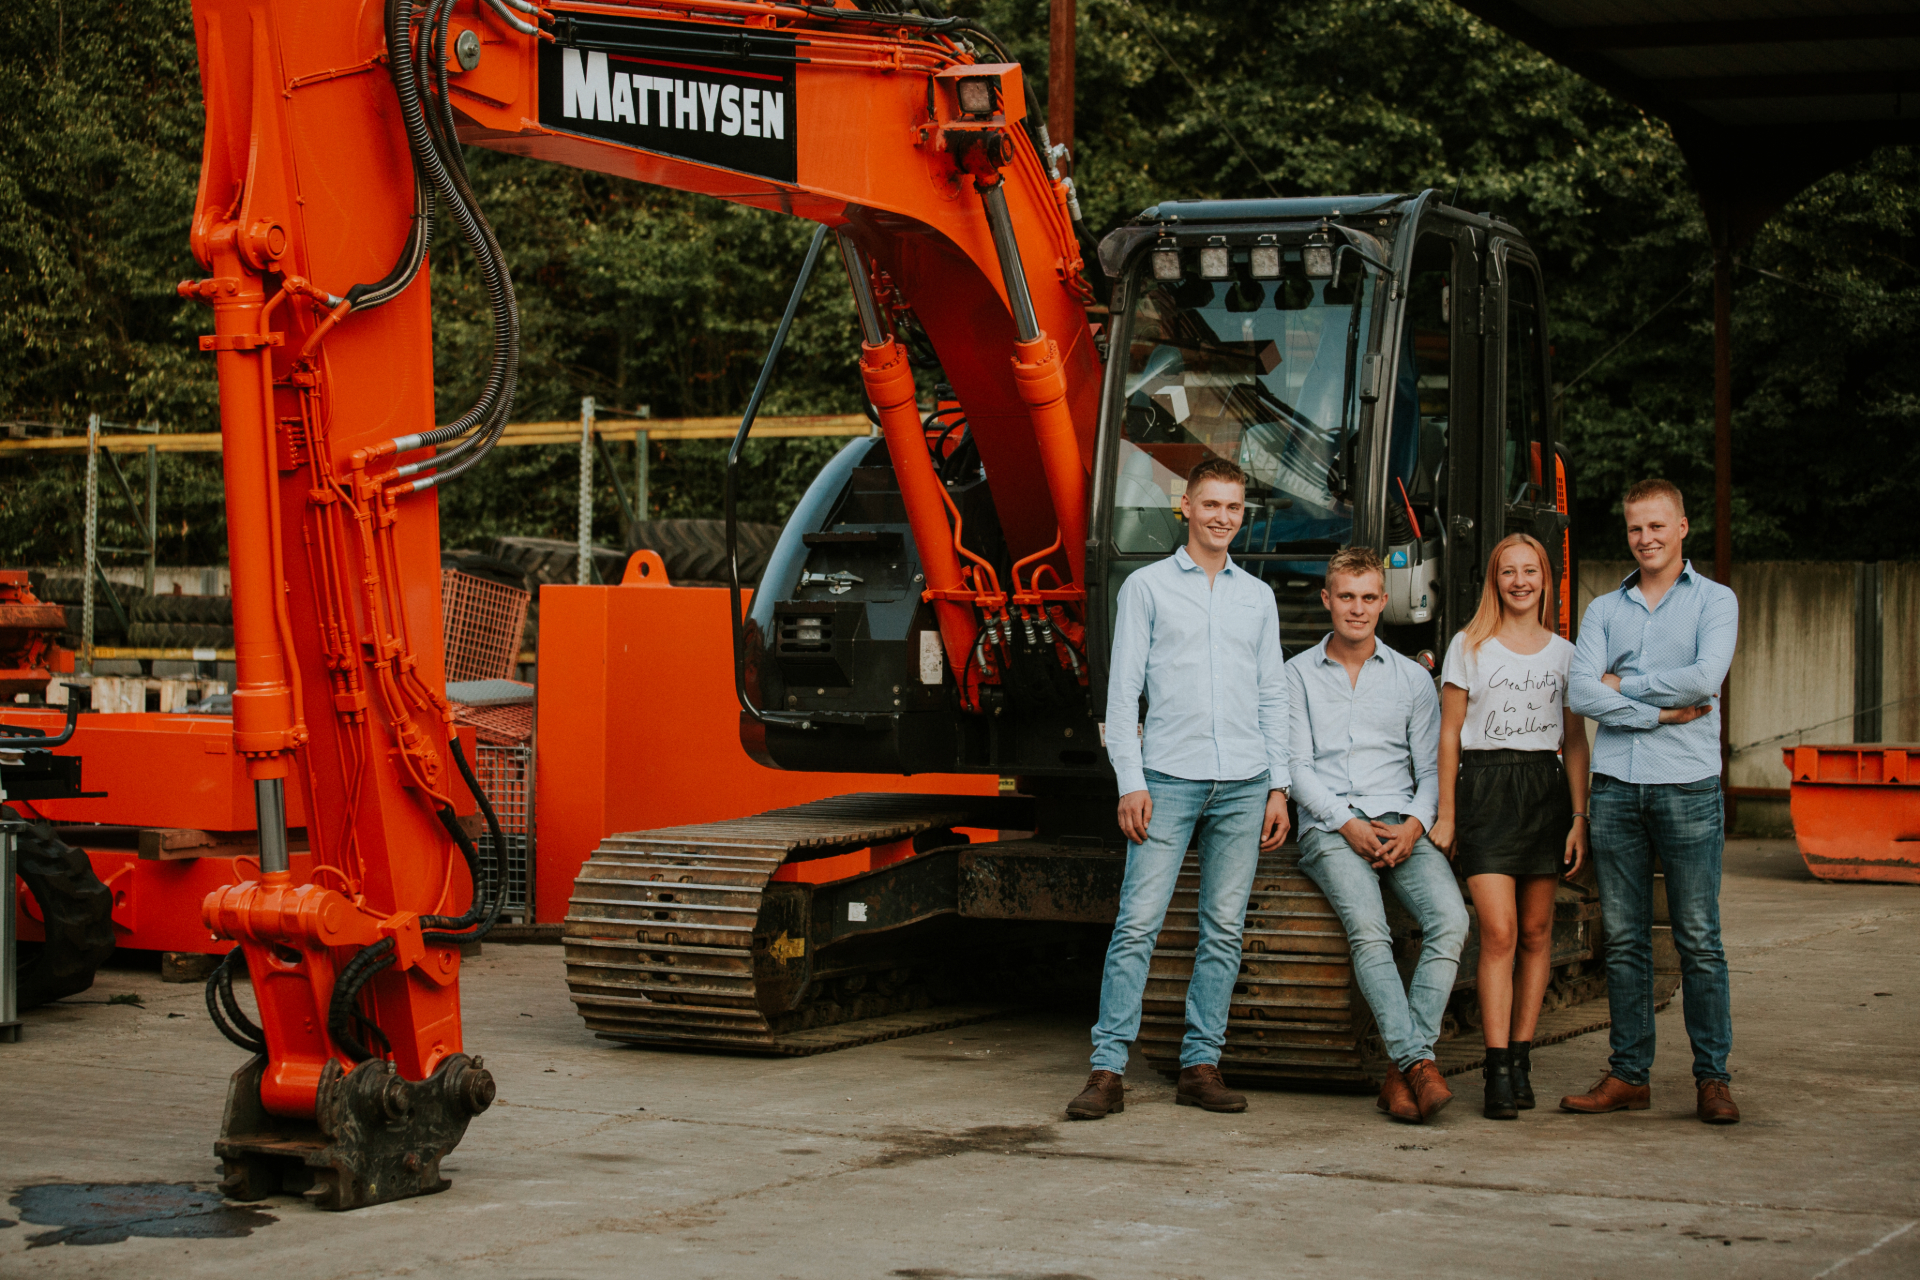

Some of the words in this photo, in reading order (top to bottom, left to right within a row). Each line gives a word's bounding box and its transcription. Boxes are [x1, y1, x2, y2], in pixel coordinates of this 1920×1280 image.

[563, 48, 784, 140] MATTHYSEN
[1489, 665, 1559, 703] Creativity
[1503, 698, 1516, 712] is
[1527, 702, 1542, 710] a
[1485, 710, 1558, 740] Rebellion
